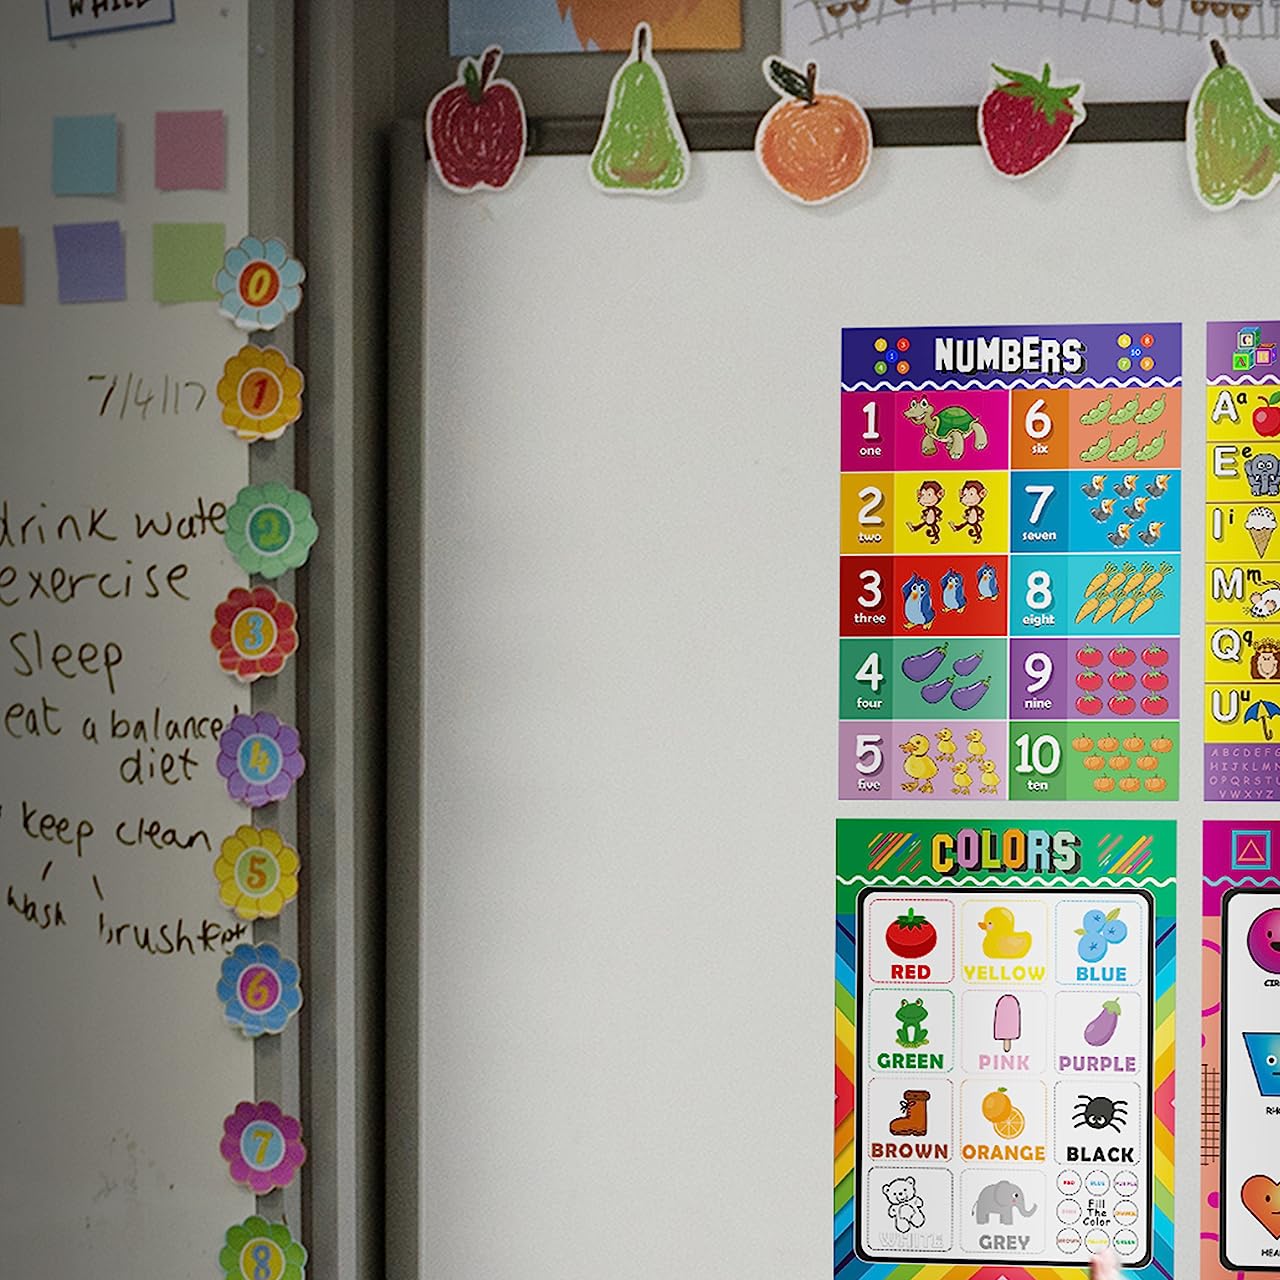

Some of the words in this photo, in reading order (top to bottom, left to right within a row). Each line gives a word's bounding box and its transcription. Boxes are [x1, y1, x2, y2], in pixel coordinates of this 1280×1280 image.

[248, 267, 270, 299] 0
[935, 336, 1085, 375] NUMBERS
[88, 372, 206, 420] 7/4/17
[252, 378, 268, 408] 1
[862, 401, 877, 440] 1
[1025, 399, 1052, 439] 6
[859, 446, 882, 456] one
[1031, 443, 1049, 455] six
[858, 487, 883, 525] 2
[1024, 485, 1055, 524] 7
[0, 500, 118, 547] drink
[135, 496, 226, 540] wate
[257, 512, 286, 546] 2
[857, 532, 882, 542] two
[1022, 530, 1057, 542] seven
[0, 560, 190, 607] exercise
[857, 570, 882, 608] 3
[1026, 571, 1052, 609] 8
[245, 615, 264, 649] 3
[854, 613, 886, 625] three
[1022, 614, 1056, 626] eight
[855, 652, 884, 692] 4
[1024, 652, 1053, 693] 9
[856, 697, 883, 709] four
[1024, 697, 1053, 709] nine
[5, 697, 61, 738] eat
[83, 717, 98, 743] a
[111, 704, 239, 742] balance
[120, 748, 198, 785] diet
[249, 741, 271, 773] 4
[855, 734, 883, 775] 5
[1014, 733, 1061, 774] 10
[857, 779, 881, 791] five
[1027, 780, 1049, 791] ten
[116, 817, 211, 852] clean
[931, 829, 1080, 875] COLORS
[246, 857, 267, 890] 5
[890, 965, 931, 980] RED
[964, 965, 1046, 981] YELLOW
[1076, 966, 1127, 982] BLUE
[247, 971, 270, 1007] 6
[877, 1052, 944, 1070] GREEN
[978, 1054, 1031, 1070] PINK
[1058, 1055, 1137, 1073] PURPLE
[251, 1130, 274, 1164] 7
[871, 1142, 949, 1160] BROWN
[961, 1144, 1046, 1161] ORANGE
[1066, 1146, 1134, 1163] BLACK
[1086, 1208, 1107, 1217] The
[1088, 1199, 1105, 1209] Fill
[1082, 1216, 1111, 1227] Color
[879, 1231, 944, 1249] WHITE
[978, 1233, 1031, 1251] GREY
[252, 1245, 272, 1280] 8
